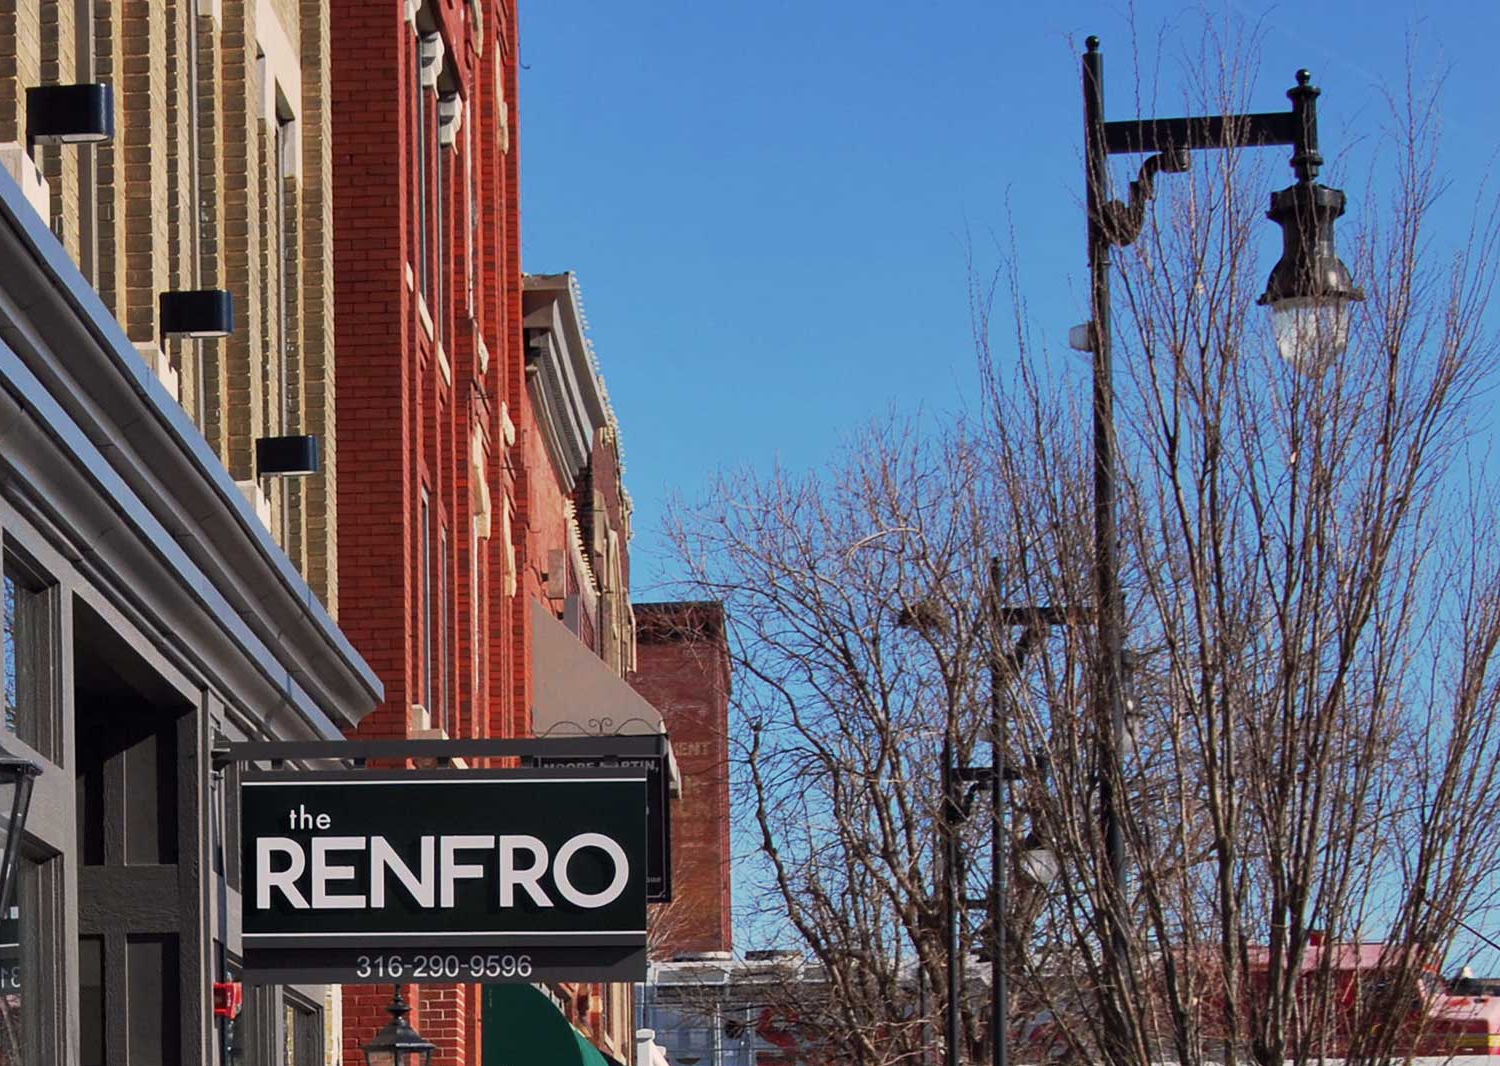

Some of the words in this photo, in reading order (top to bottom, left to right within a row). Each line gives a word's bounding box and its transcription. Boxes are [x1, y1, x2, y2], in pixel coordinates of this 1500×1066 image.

[289, 804, 332, 830] the
[257, 832, 630, 909] RENFRO
[356, 955, 533, 978] 316-290-9596
